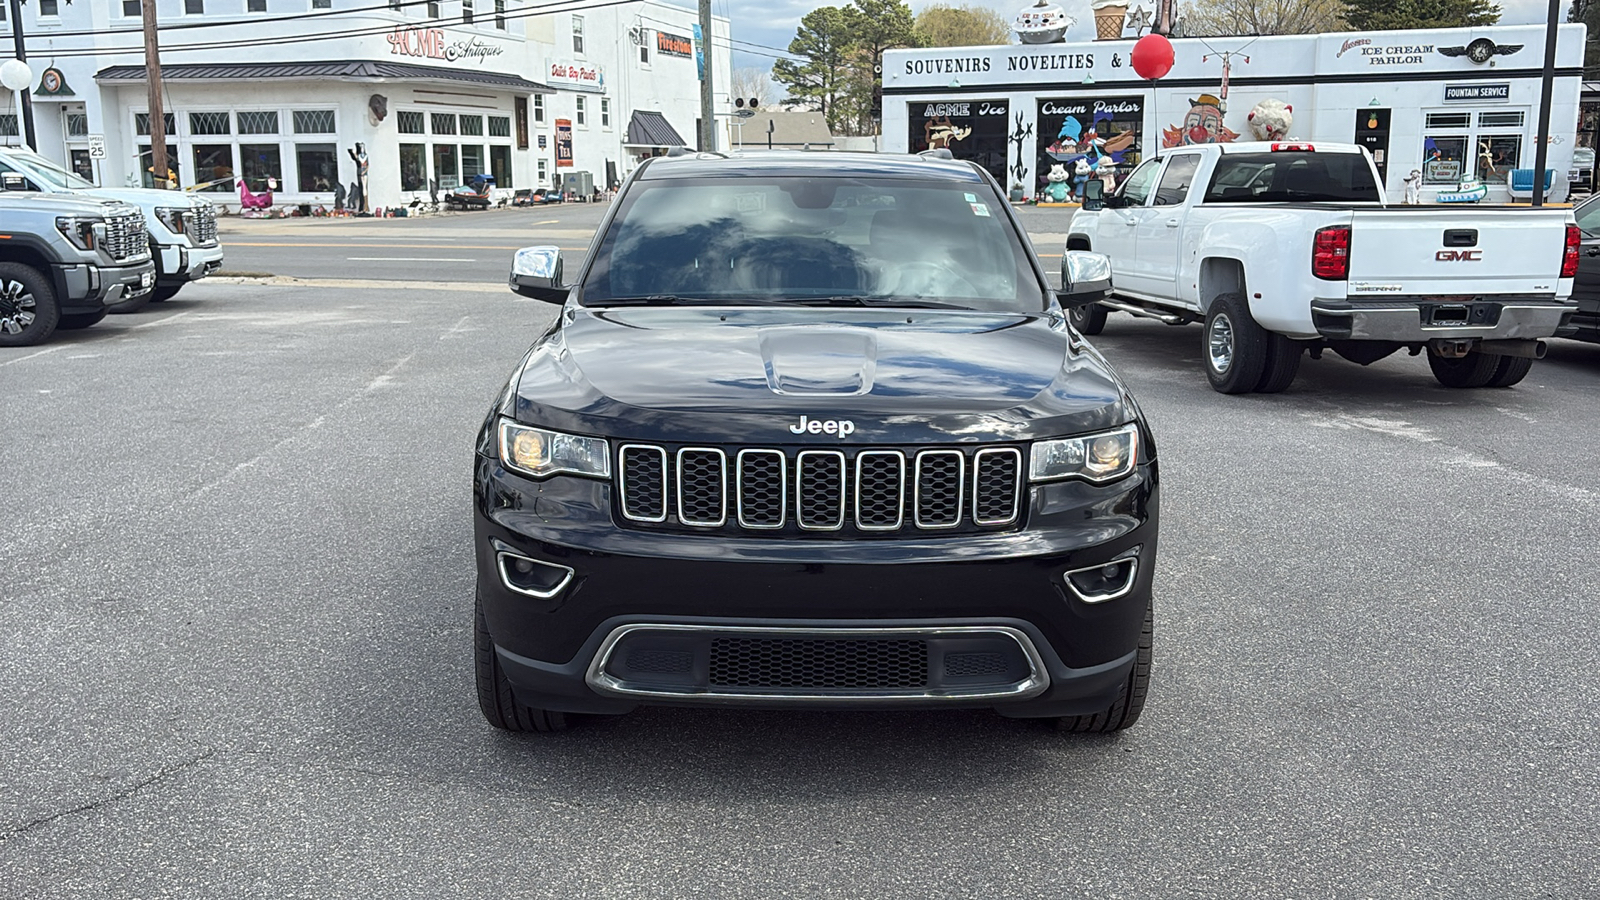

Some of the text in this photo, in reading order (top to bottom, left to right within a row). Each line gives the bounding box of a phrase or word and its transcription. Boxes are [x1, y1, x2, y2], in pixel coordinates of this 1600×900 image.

[387, 24, 503, 64] ACME Antiques
[1361, 47, 1382, 56] ICE
[1386, 45, 1434, 55] CREAM
[905, 56, 991, 75] SOUVENIRS
[1008, 53, 1095, 71] NOVELTIES
[1111, 53, 1123, 68] &
[1370, 56, 1423, 65] PARLOR
[552, 64, 596, 82] Dutch Boy Paints
[1447, 87, 1508, 98] FOUNTAIN SERVICE
[924, 101, 1141, 117] ACME Ice Cream Parlor
[91, 146, 104, 157] 25
[559, 145, 571, 158] TEA
[1435, 250, 1482, 261] GMC
[789, 415, 855, 439] Jeep
